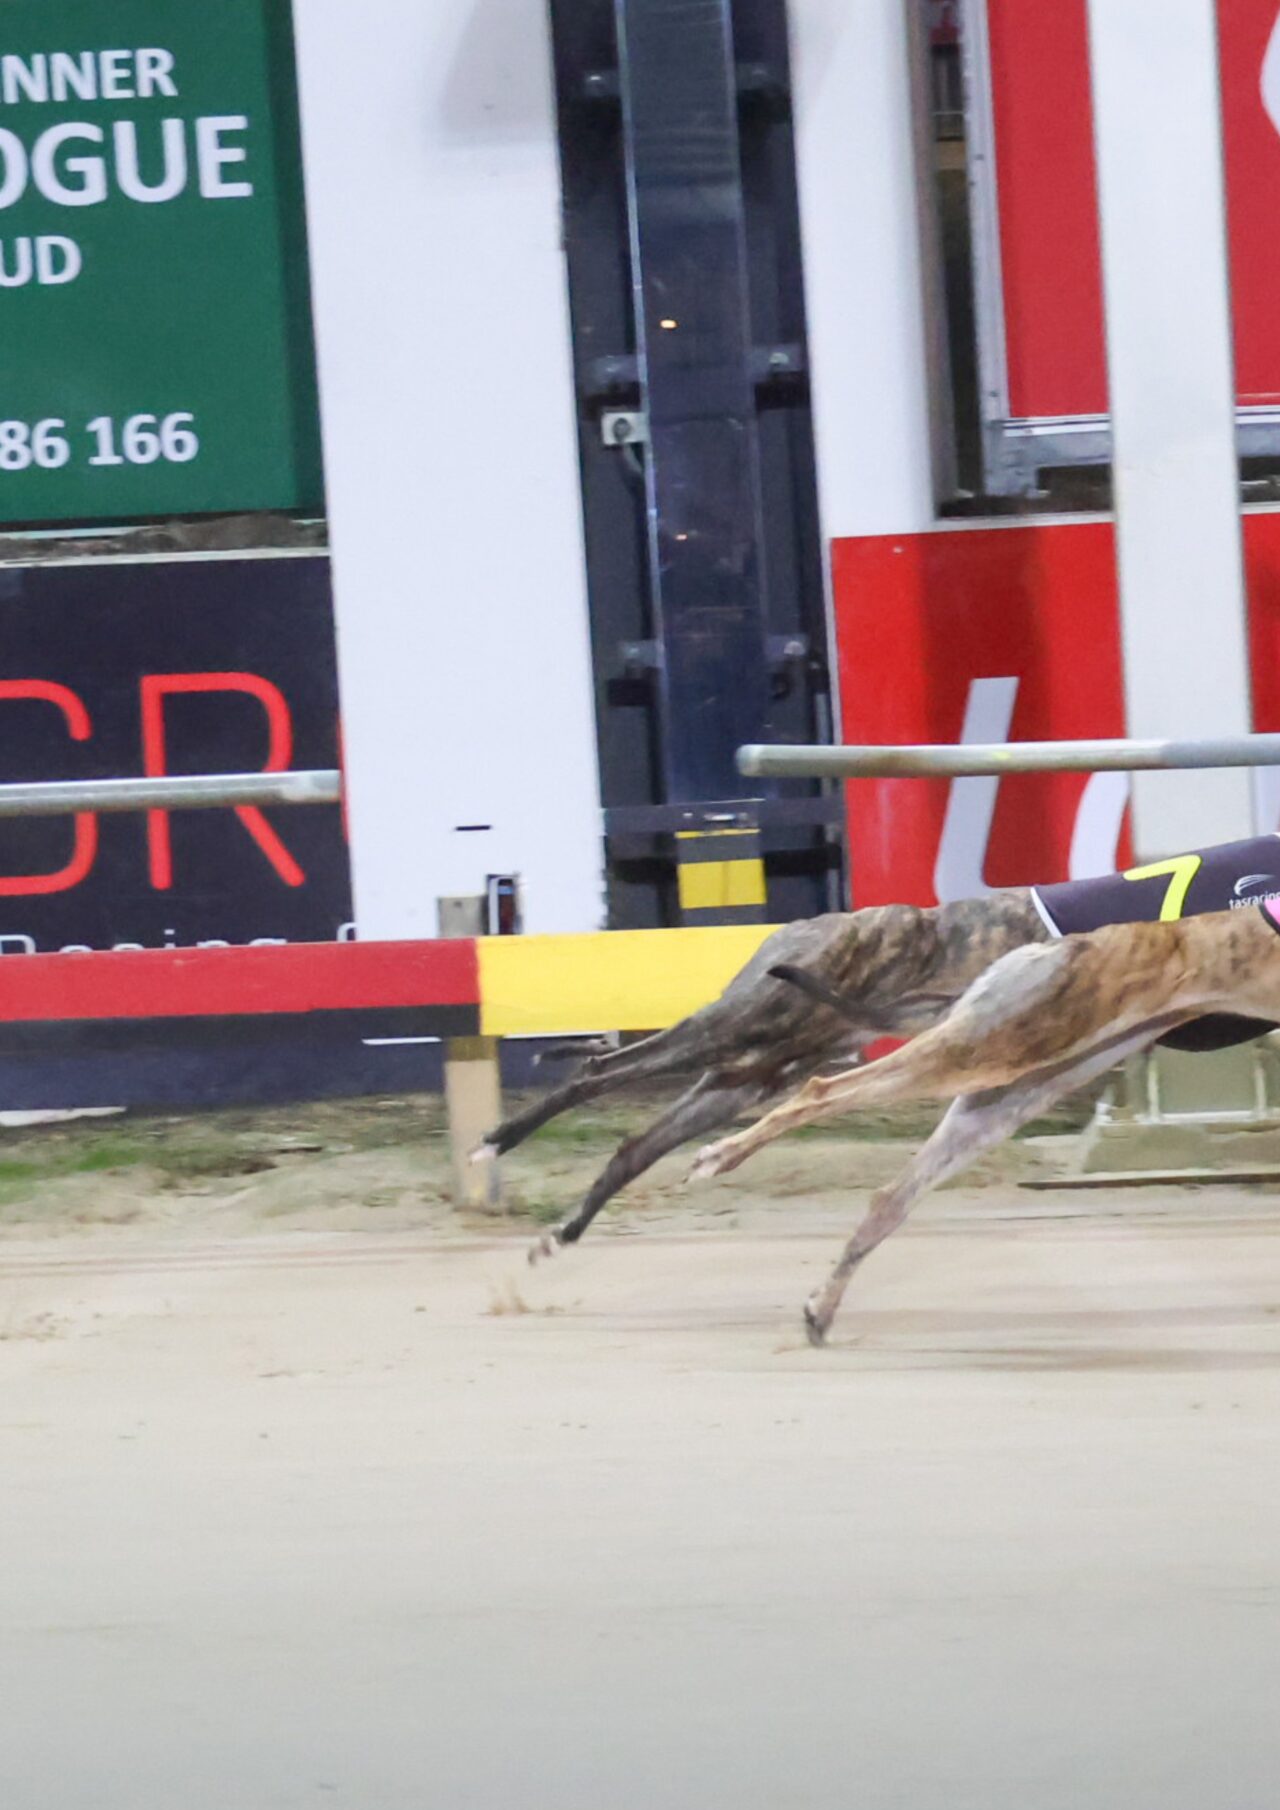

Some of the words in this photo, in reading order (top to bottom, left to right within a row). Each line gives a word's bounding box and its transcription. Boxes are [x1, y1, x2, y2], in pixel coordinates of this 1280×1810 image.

[2, 48, 178, 103] NNER
[0, 418, 70, 470] 86
[87, 412, 199, 466] 166
[1122, 854, 1202, 922] 7
